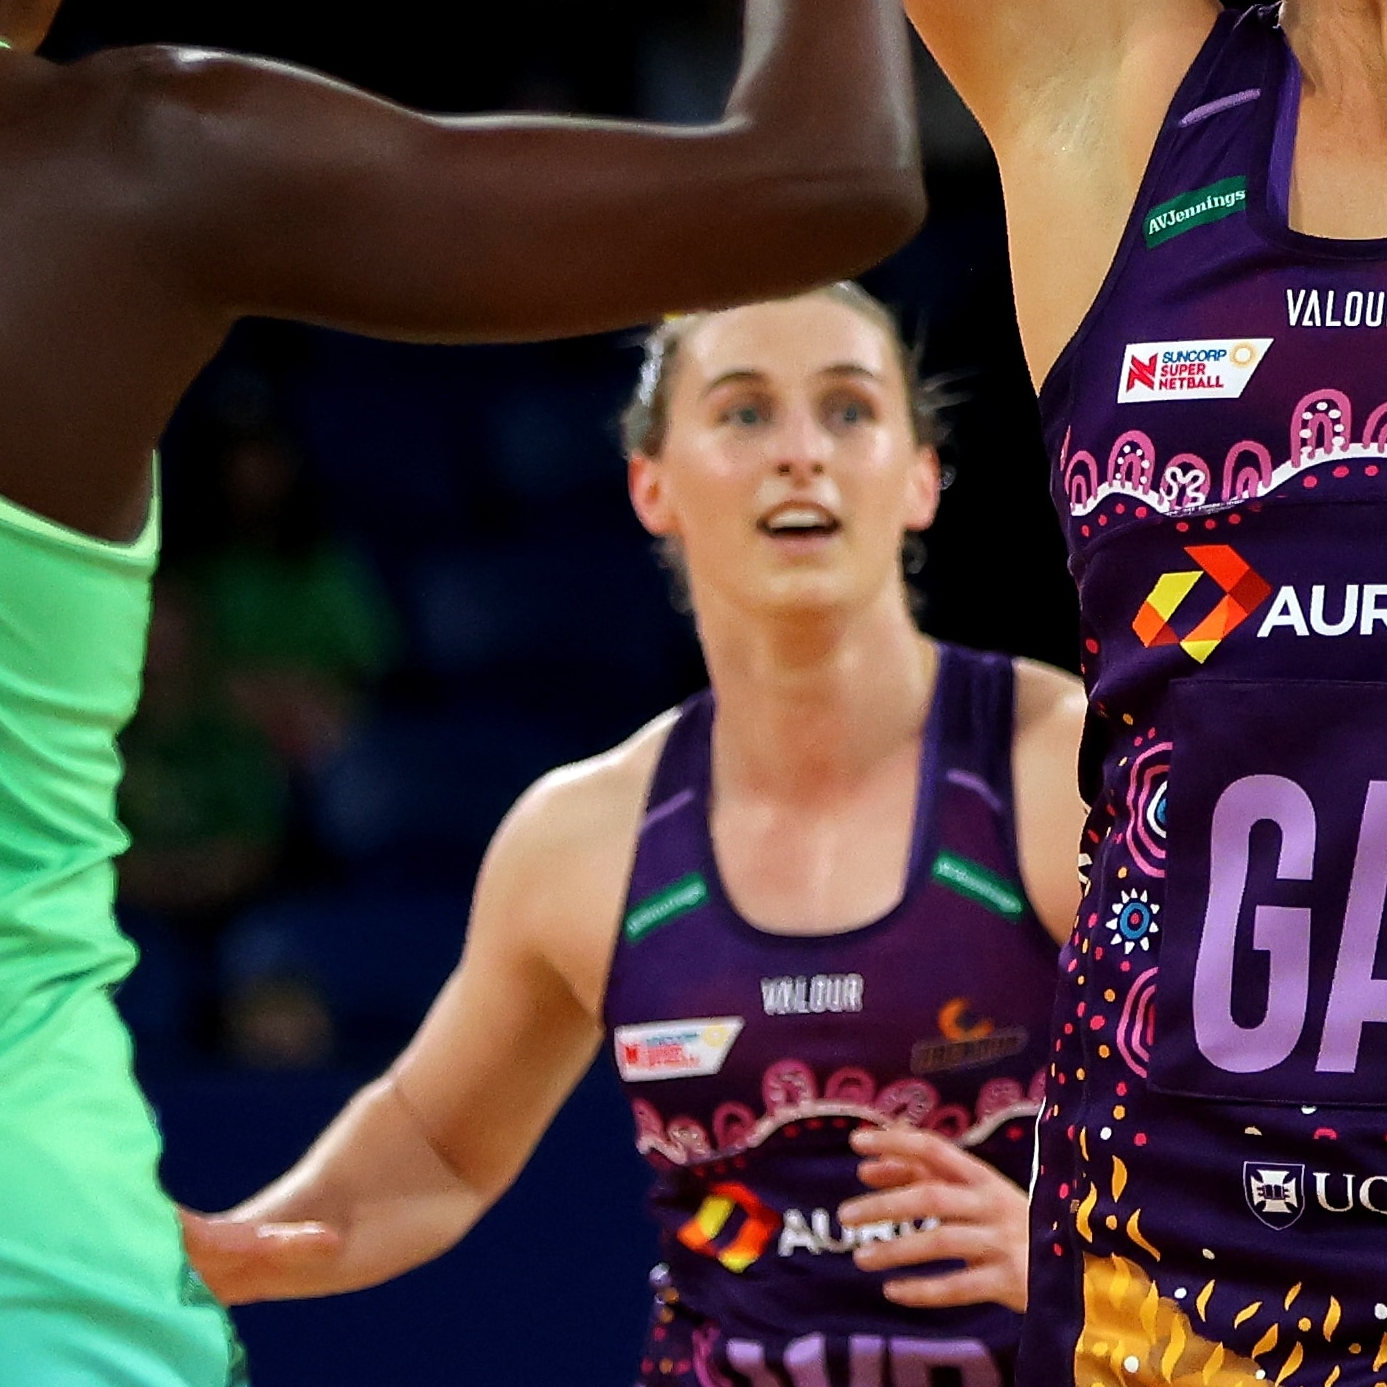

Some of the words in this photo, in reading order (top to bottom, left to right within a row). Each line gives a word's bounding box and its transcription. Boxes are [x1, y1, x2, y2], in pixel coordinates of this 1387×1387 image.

[1147, 189, 1246, 235] AVJennings
[1162, 349, 1227, 364] SUNCORP
[1160, 363, 1206, 377] SUPER
[1159, 375, 1224, 391] NETBALL
